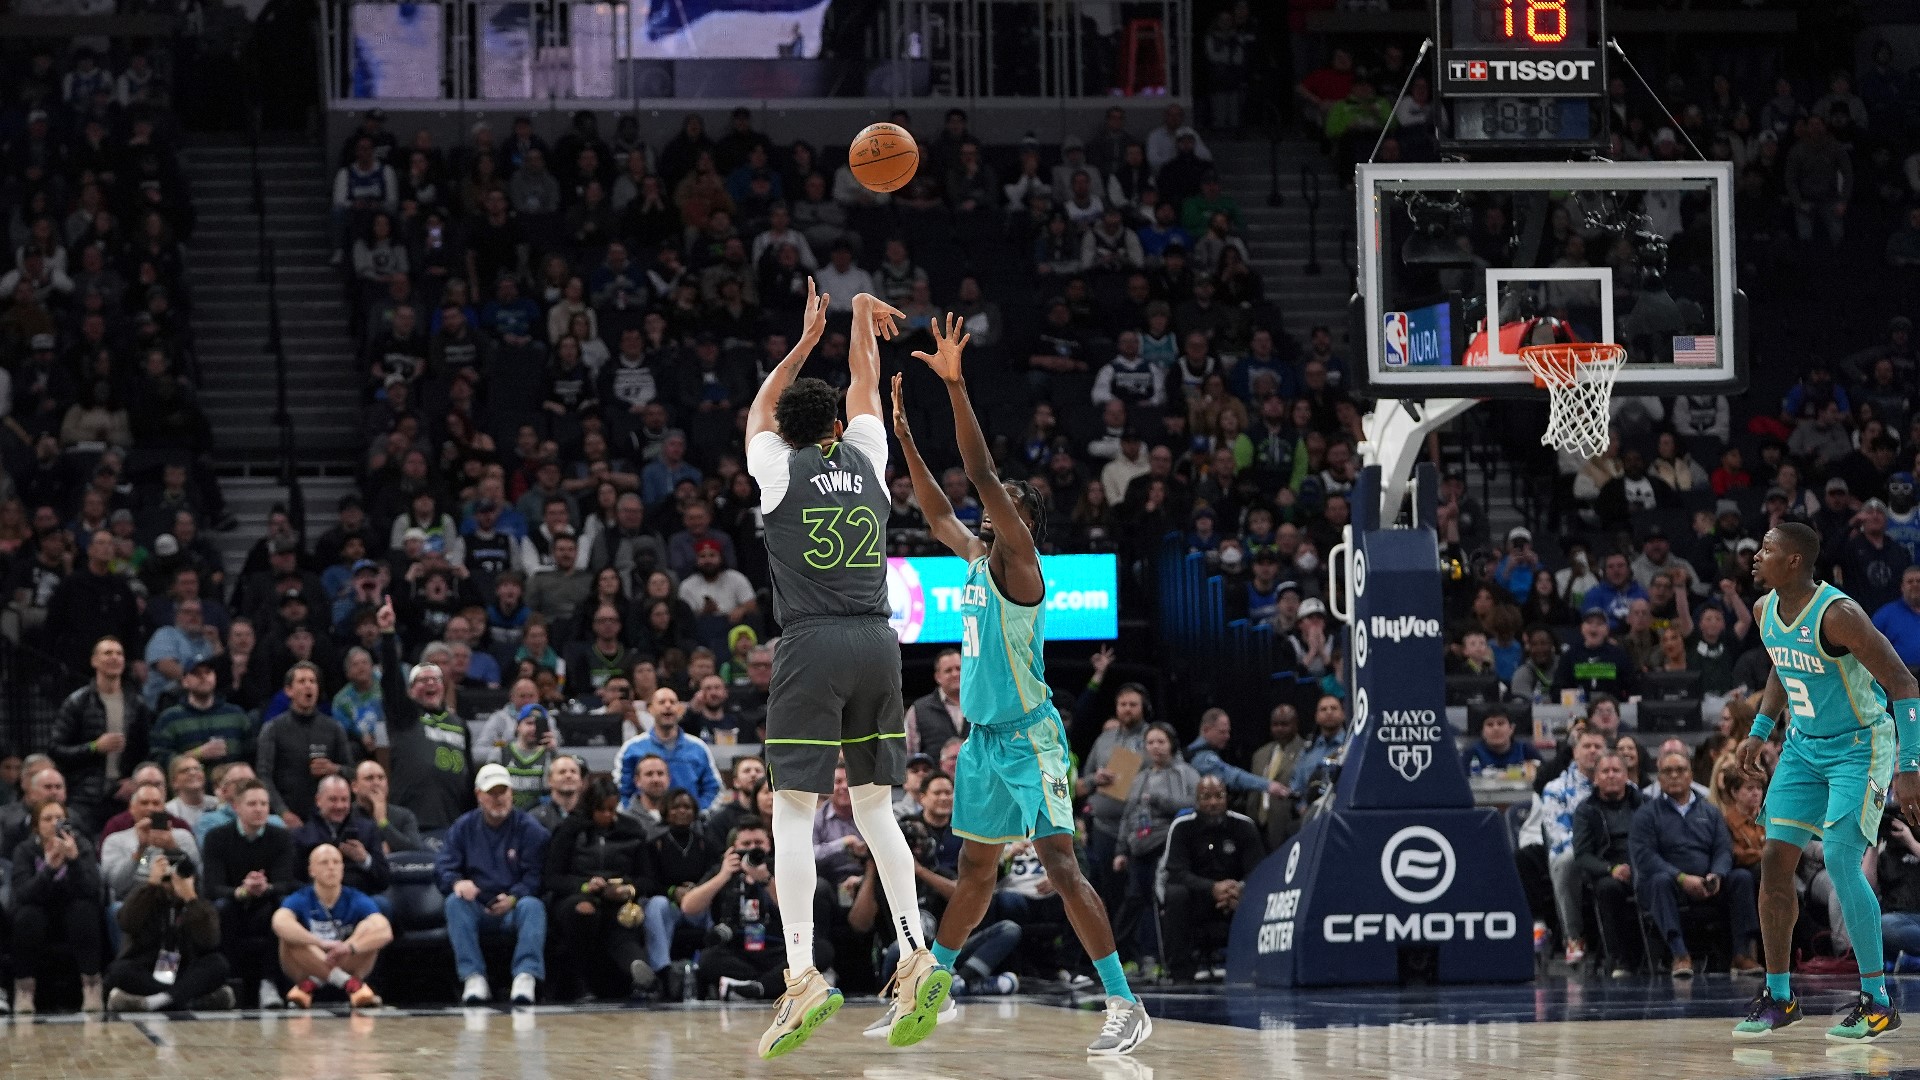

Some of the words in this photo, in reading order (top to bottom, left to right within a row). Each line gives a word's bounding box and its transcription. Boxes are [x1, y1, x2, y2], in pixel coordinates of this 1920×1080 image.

[1503, 0, 1567, 43] 18
[1488, 60, 1596, 81] TISSOT
[809, 470, 863, 496] TOWNS
[802, 505, 882, 570] 32
[1791, 649, 1825, 675] CITY
[1785, 677, 1815, 718] 3
[1382, 709, 1436, 726] MAYO
[1376, 726, 1442, 743] CLINIC
[1264, 889, 1301, 922] TARGET
[1258, 922, 1294, 954] CENTER
[1323, 910, 1517, 943] CFMOTO
